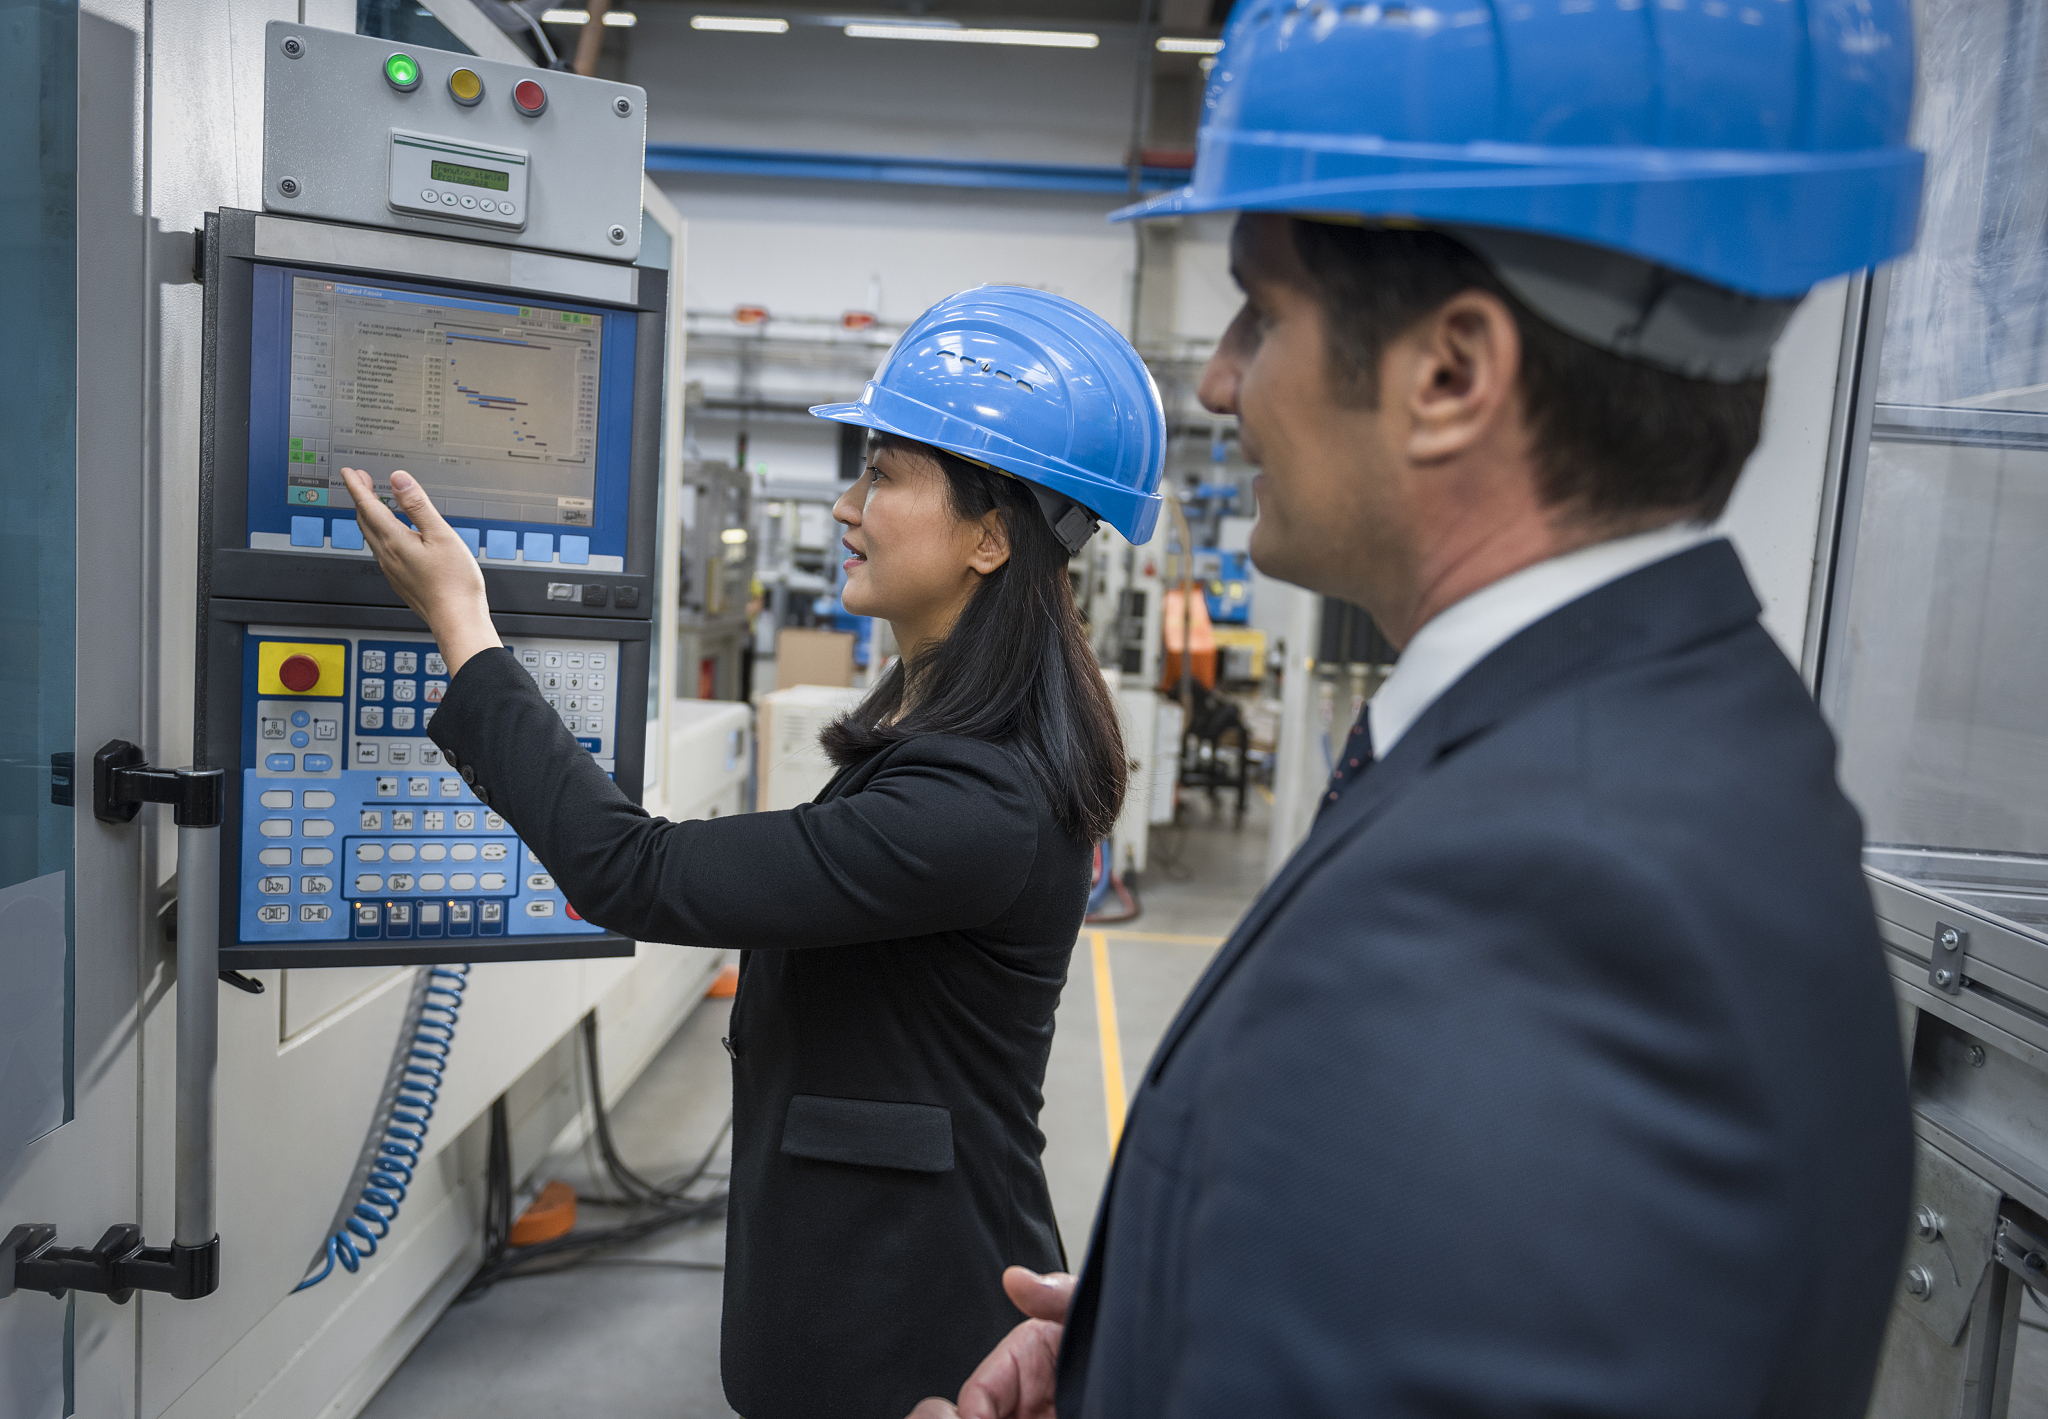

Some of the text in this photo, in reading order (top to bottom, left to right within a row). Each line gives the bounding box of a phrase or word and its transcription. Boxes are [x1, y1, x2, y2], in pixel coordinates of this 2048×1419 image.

[434, 164, 470, 177] Trenutno
[437, 172, 489, 187] Proizvodnja
[504, 204, 509, 212] F
[337, 286, 362, 295] Pregled
[549, 678, 556, 686] 8
[571, 679, 578, 687] 9
[570, 700, 576, 708] 6
[366, 714, 378, 727] S
[398, 715, 409, 727] F
[569, 722, 576, 730] 3
